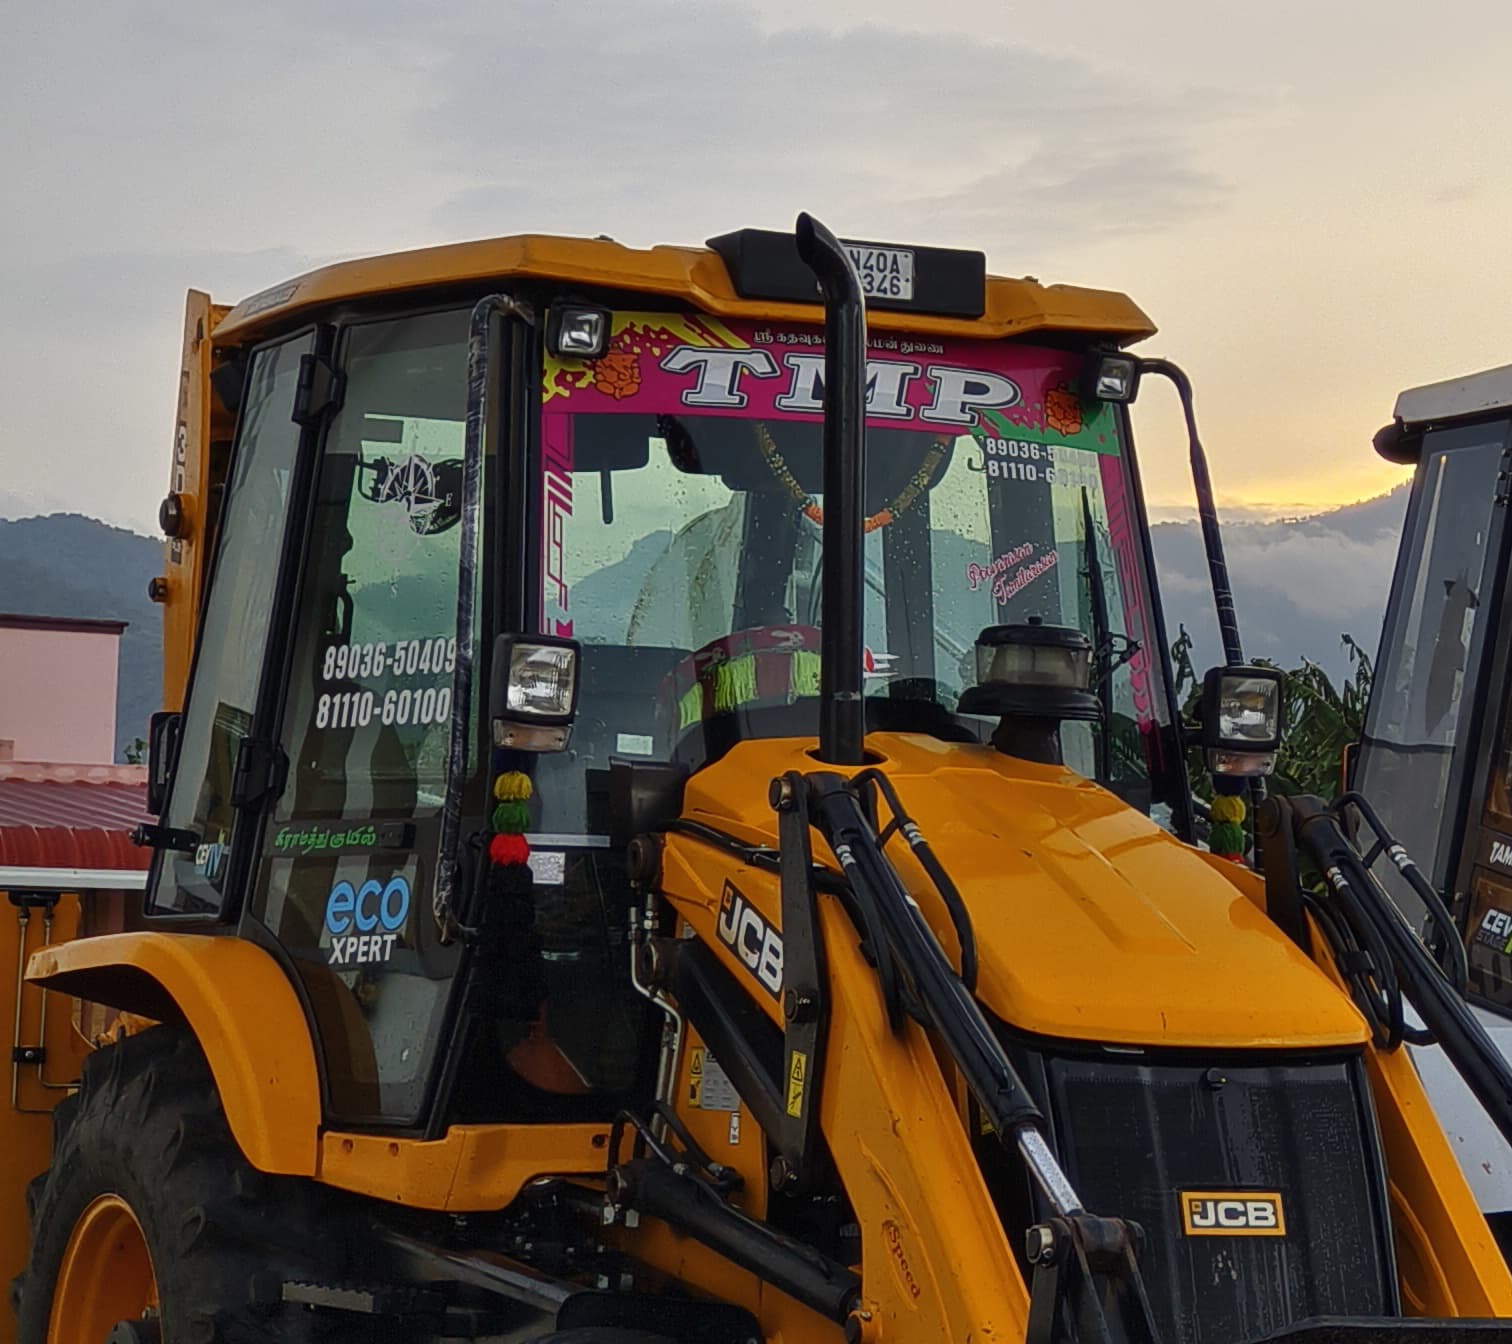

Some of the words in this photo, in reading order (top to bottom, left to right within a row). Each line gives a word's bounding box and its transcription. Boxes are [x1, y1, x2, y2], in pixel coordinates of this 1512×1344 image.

[849, 249, 901, 275] N40A
[858, 273, 901, 296] 346
[660, 345, 1021, 427] TMP
[322, 637, 456, 681] 89036-50409
[315, 687, 450, 729] 81110-60100
[327, 880, 410, 934] eco
[328, 934, 397, 964] XPERT
[719, 896, 784, 993] JCB
[1192, 1201, 1277, 1226] JCB
